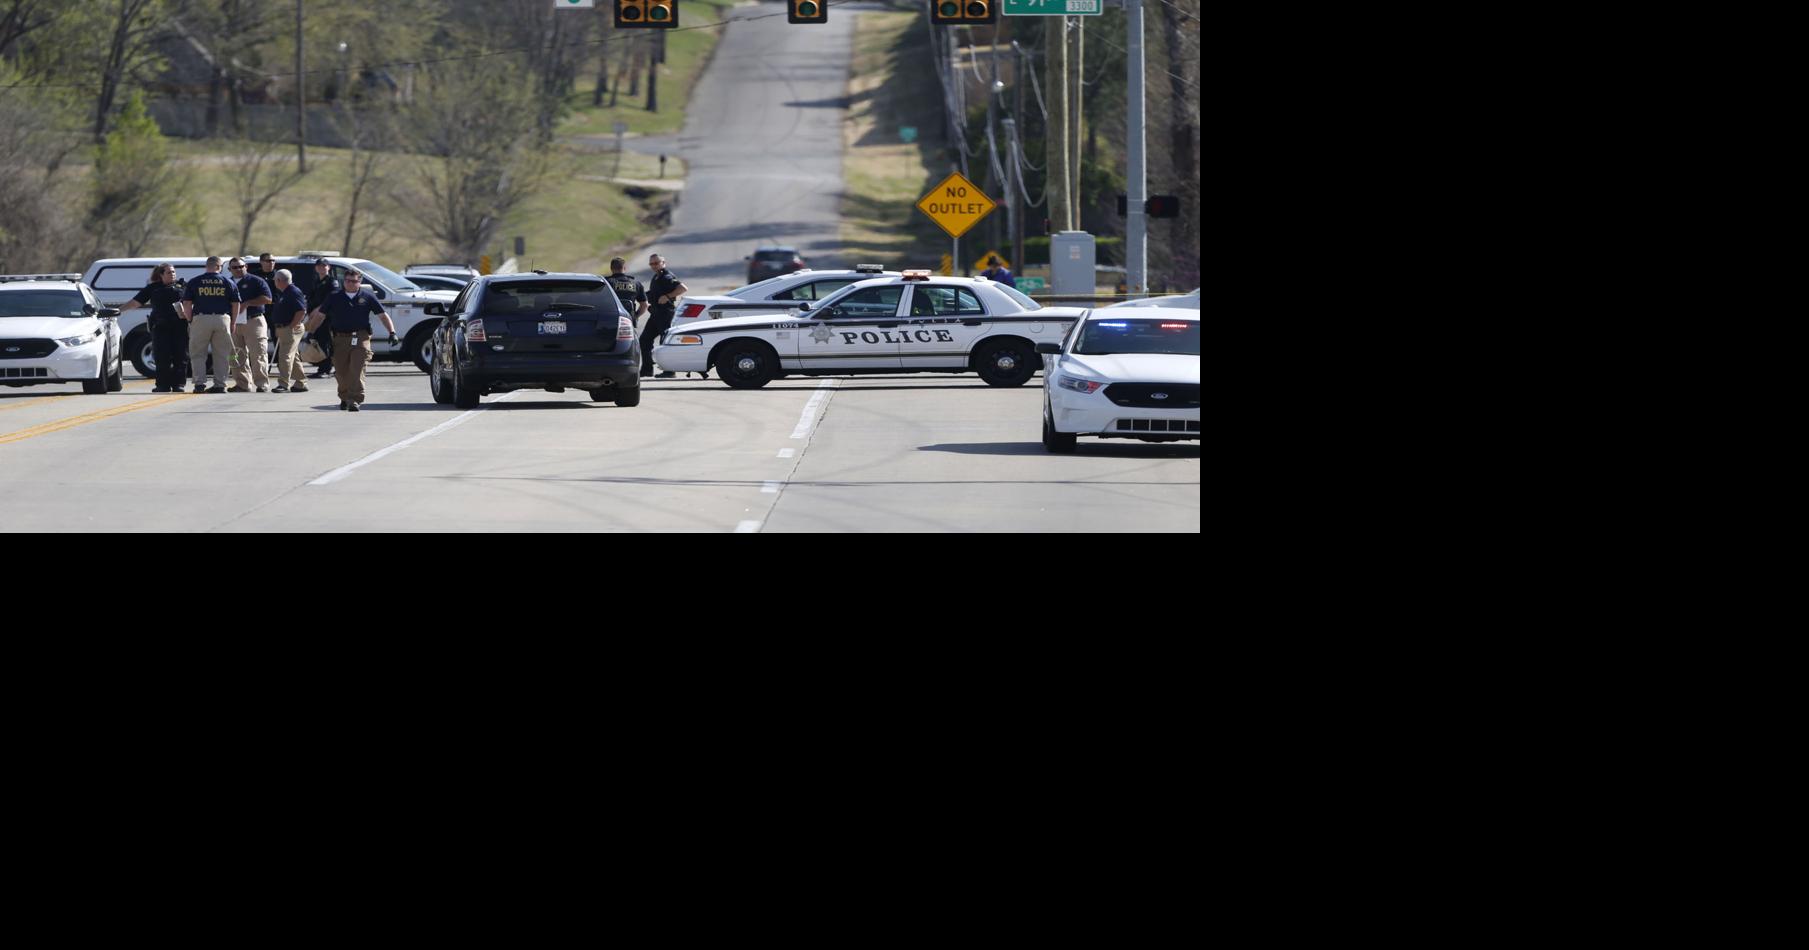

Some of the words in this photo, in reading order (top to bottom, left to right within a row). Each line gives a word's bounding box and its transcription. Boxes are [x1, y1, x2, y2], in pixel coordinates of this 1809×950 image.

[1071, 1, 1094, 11] 3300
[946, 186, 967, 198] NO
[929, 202, 984, 214] OUTLET
[198, 287, 225, 296] POLICE
[840, 329, 954, 345] POLICE
